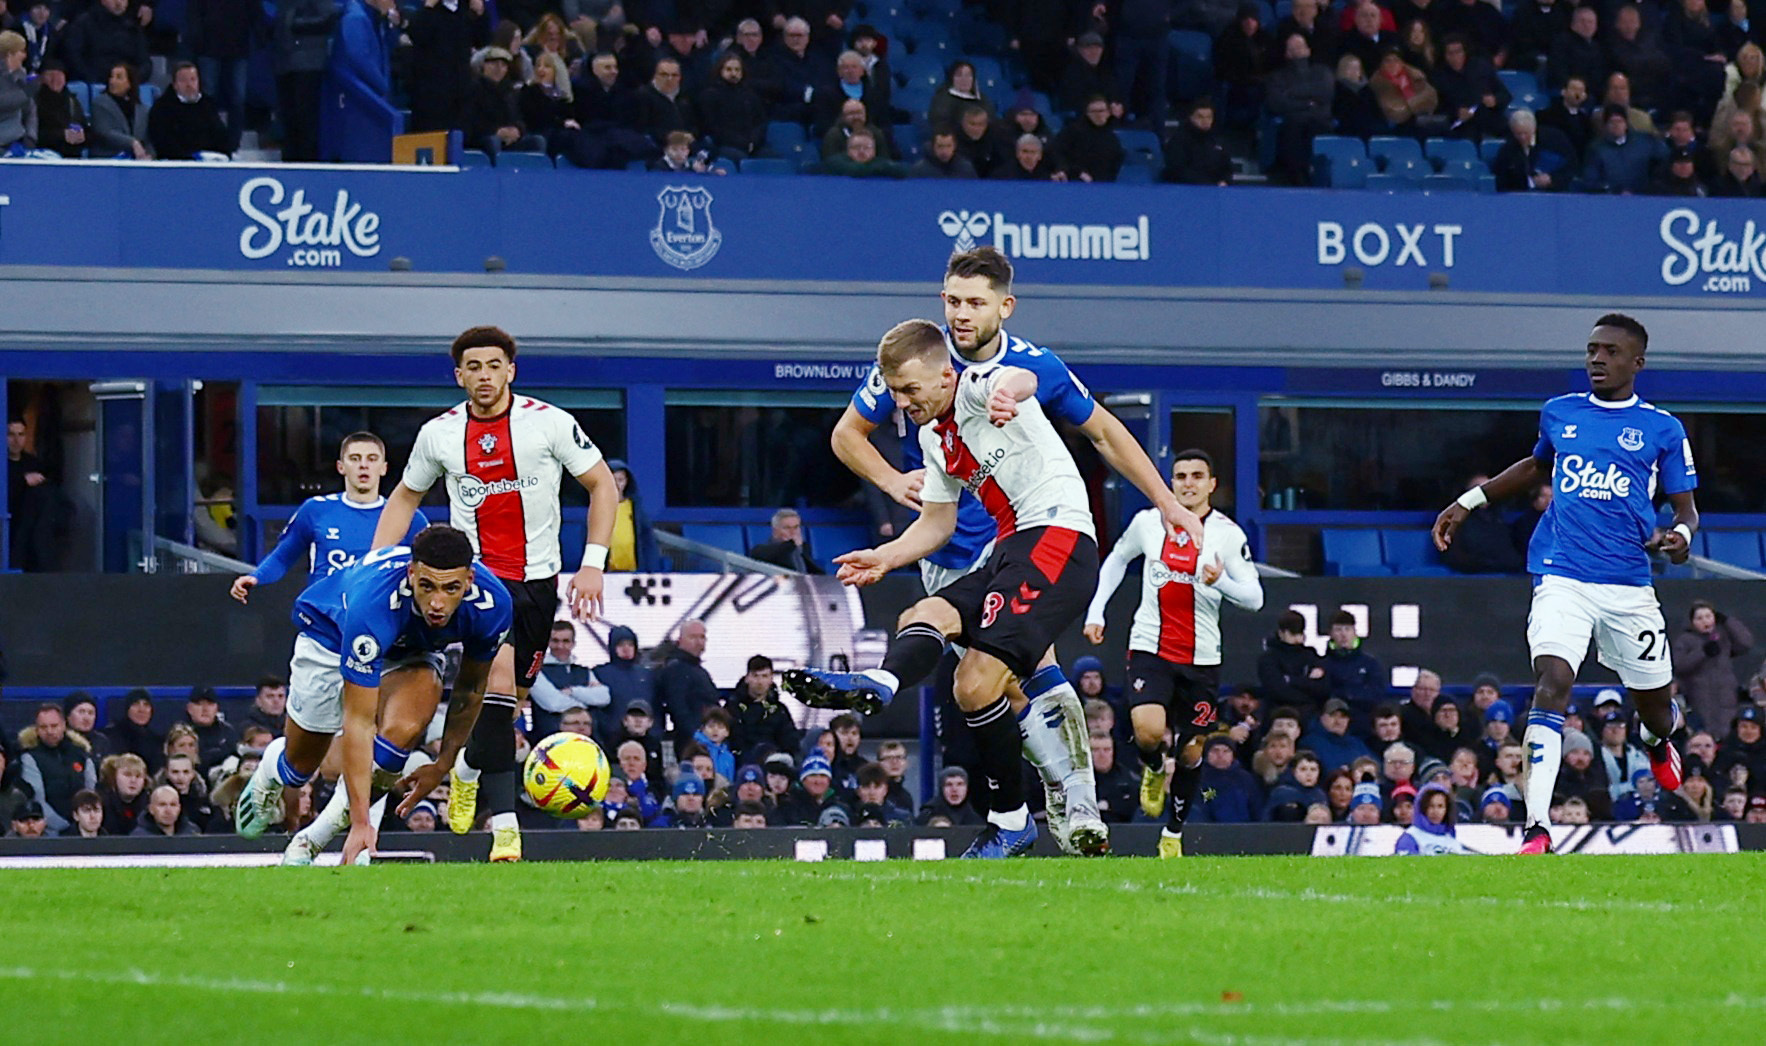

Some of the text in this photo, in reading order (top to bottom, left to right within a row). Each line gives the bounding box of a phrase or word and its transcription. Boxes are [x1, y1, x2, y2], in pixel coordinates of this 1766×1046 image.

[239, 177, 380, 259] Stake
[993, 212, 1149, 261] hummel
[1317, 221, 1462, 268] BOXT
[287, 249, 341, 266] .com
[1702, 276, 1751, 292] .com
[775, 364, 871, 379] BROWNLOW UT
[1382, 372, 1476, 387] GIBBS & DANDY
[460, 476, 539, 499] Sportsbet.io
[1560, 454, 1631, 498] Stake
[1578, 488, 1612, 501] .com
[1151, 567, 1201, 583] Sportsbet
[980, 591, 1005, 629] 8
[1637, 629, 1668, 661] 27
